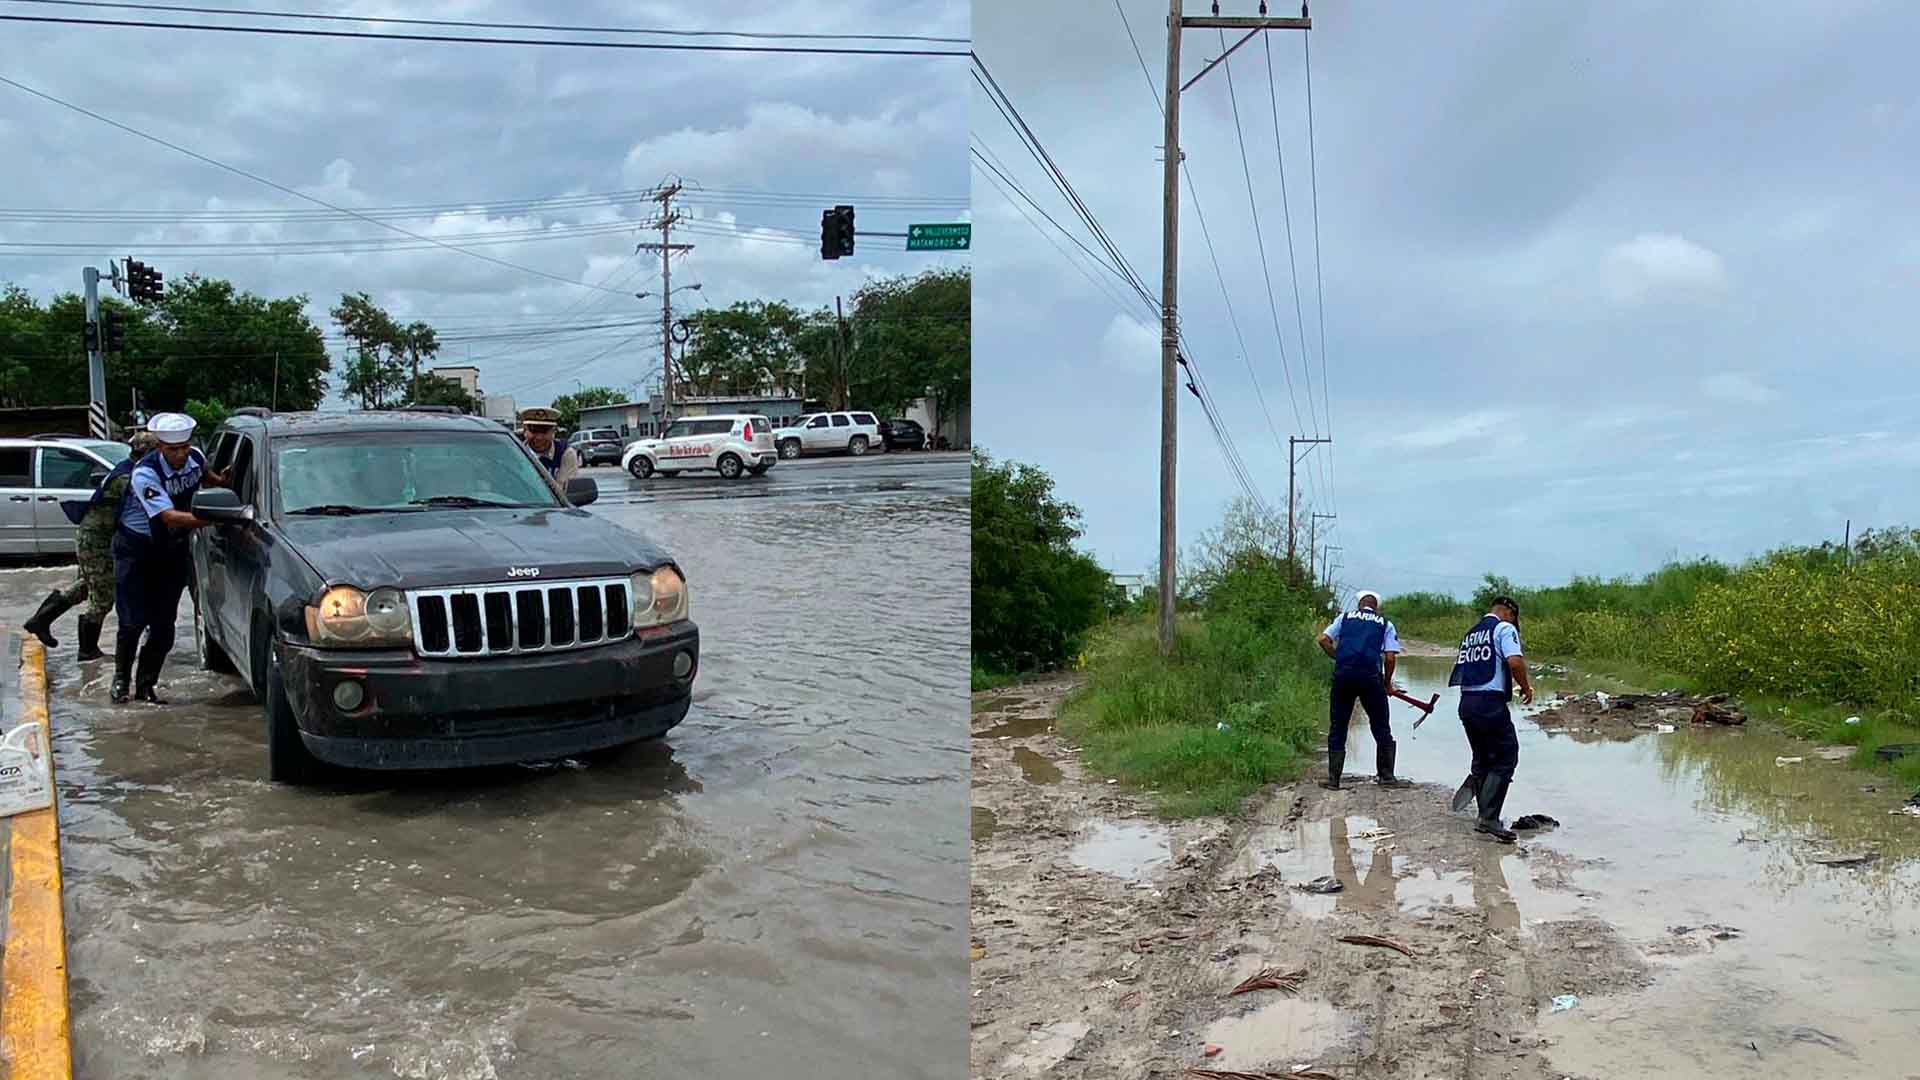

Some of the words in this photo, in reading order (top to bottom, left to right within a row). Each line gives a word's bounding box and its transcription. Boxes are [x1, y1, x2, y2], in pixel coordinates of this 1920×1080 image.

[910, 238, 955, 248] MATAMOROS
[507, 567, 540, 577] Jeep
[1346, 610, 1385, 626] MARINA
[1459, 629, 1491, 649] ARINA
[1456, 645, 1491, 664] EXICO
